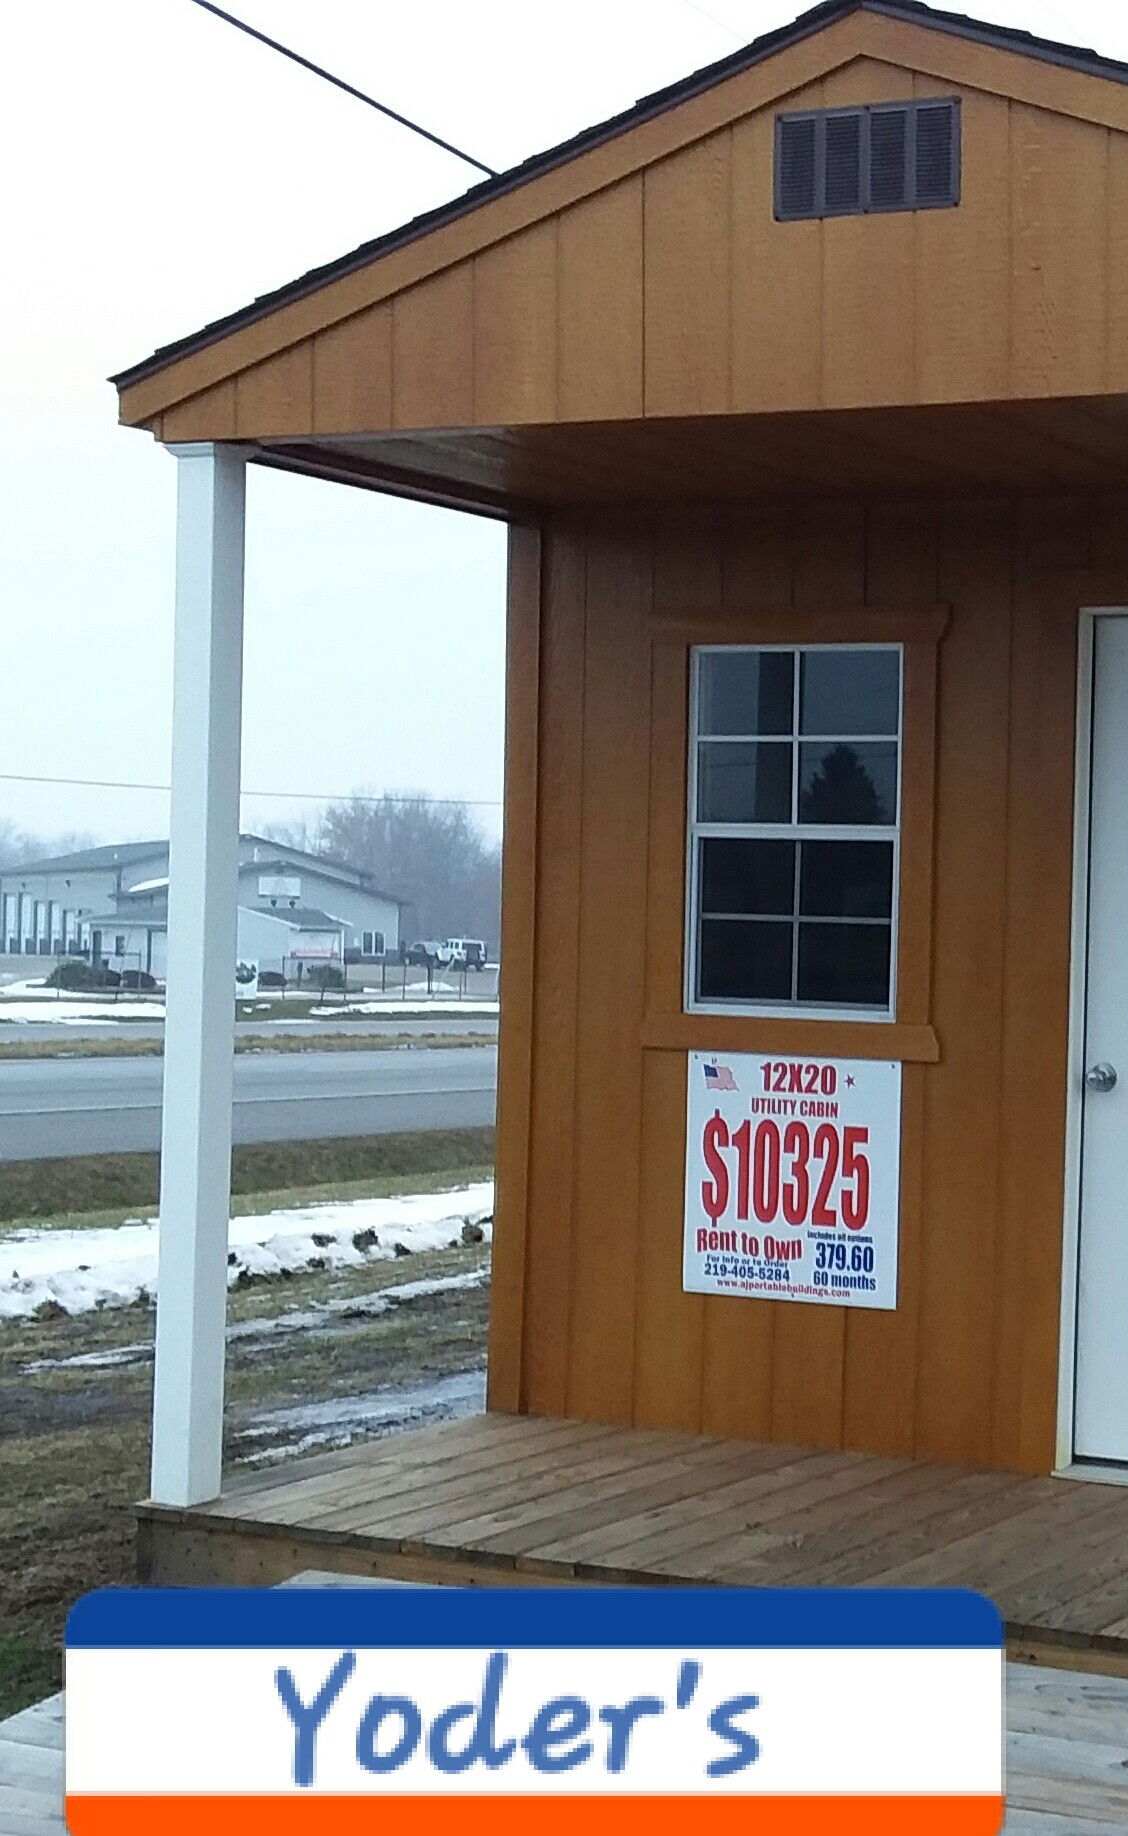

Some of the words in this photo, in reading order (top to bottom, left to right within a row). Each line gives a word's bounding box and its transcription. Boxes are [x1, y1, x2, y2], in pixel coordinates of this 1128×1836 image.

[760, 1062, 837, 1095] 12X20
[751, 1097, 796, 1116] UTILITY
[799, 1100, 839, 1118] CABIN
[702, 1108, 870, 1230] $10325
[696, 1228, 737, 1253] Rent
[741, 1232, 759, 1257] to
[763, 1235, 802, 1260] Own
[706, 1254, 720, 1263] For
[741, 1258, 750, 1266] or
[753, 1258, 761, 1267] to
[763, 1259, 788, 1269] Order
[815, 1242, 874, 1272] 379.60
[704, 1262, 790, 1282] 219-405-5284
[813, 1270, 828, 1286] 60
[831, 1273, 876, 1291] months
